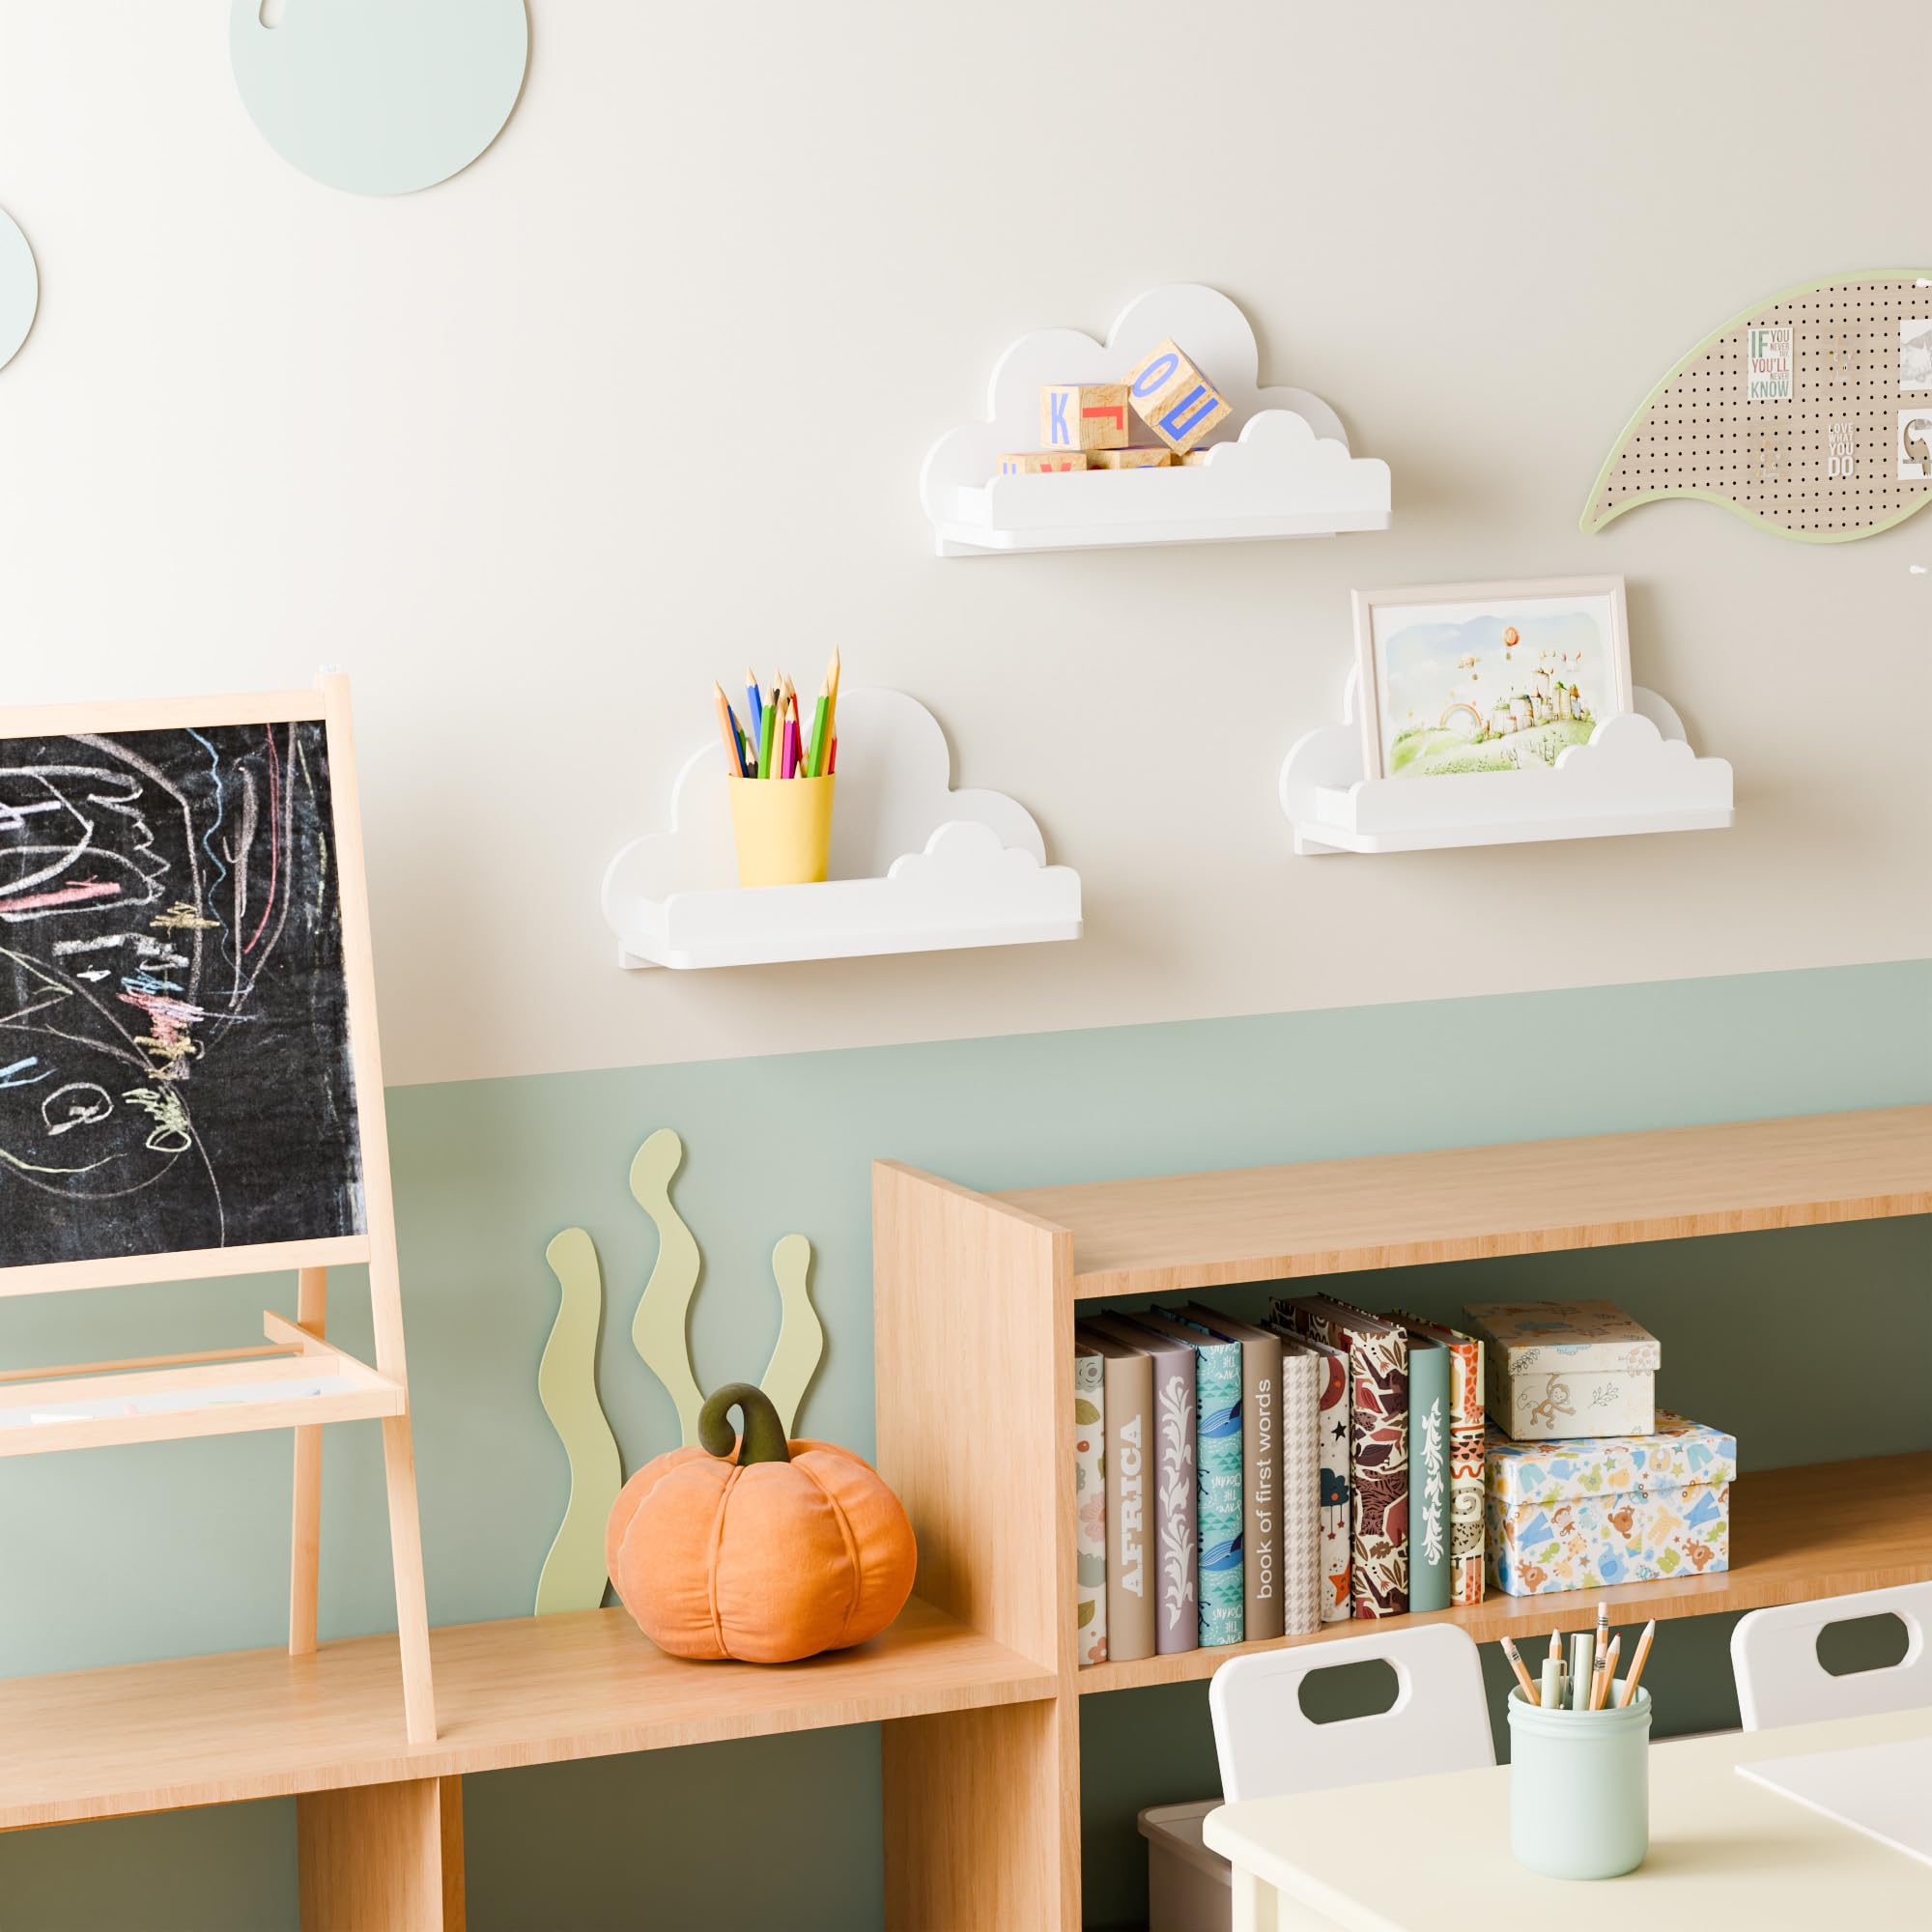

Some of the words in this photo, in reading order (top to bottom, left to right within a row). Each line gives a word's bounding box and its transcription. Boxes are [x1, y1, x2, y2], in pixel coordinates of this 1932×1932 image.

[1751, 330, 1770, 358] IF
[1771, 329, 1789, 343] YOU
[1770, 343, 1790, 352] NEVER
[1751, 357, 1790, 373] YOU'LL
[1770, 372, 1790, 381] NEVER
[1751, 381, 1789, 398] KNOW
[1828, 423, 1854, 434] LOVE
[1828, 433, 1853, 442] WHAT
[1829, 441, 1854, 456] YOU
[1828, 456, 1854, 476] DO
[1255, 1378, 1271, 1453] words
[1256, 1458, 1272, 1504] first
[1120, 1414, 1144, 1598] AFRICA
[1256, 1510, 1272, 1534] of
[1256, 1539, 1272, 1600] book
